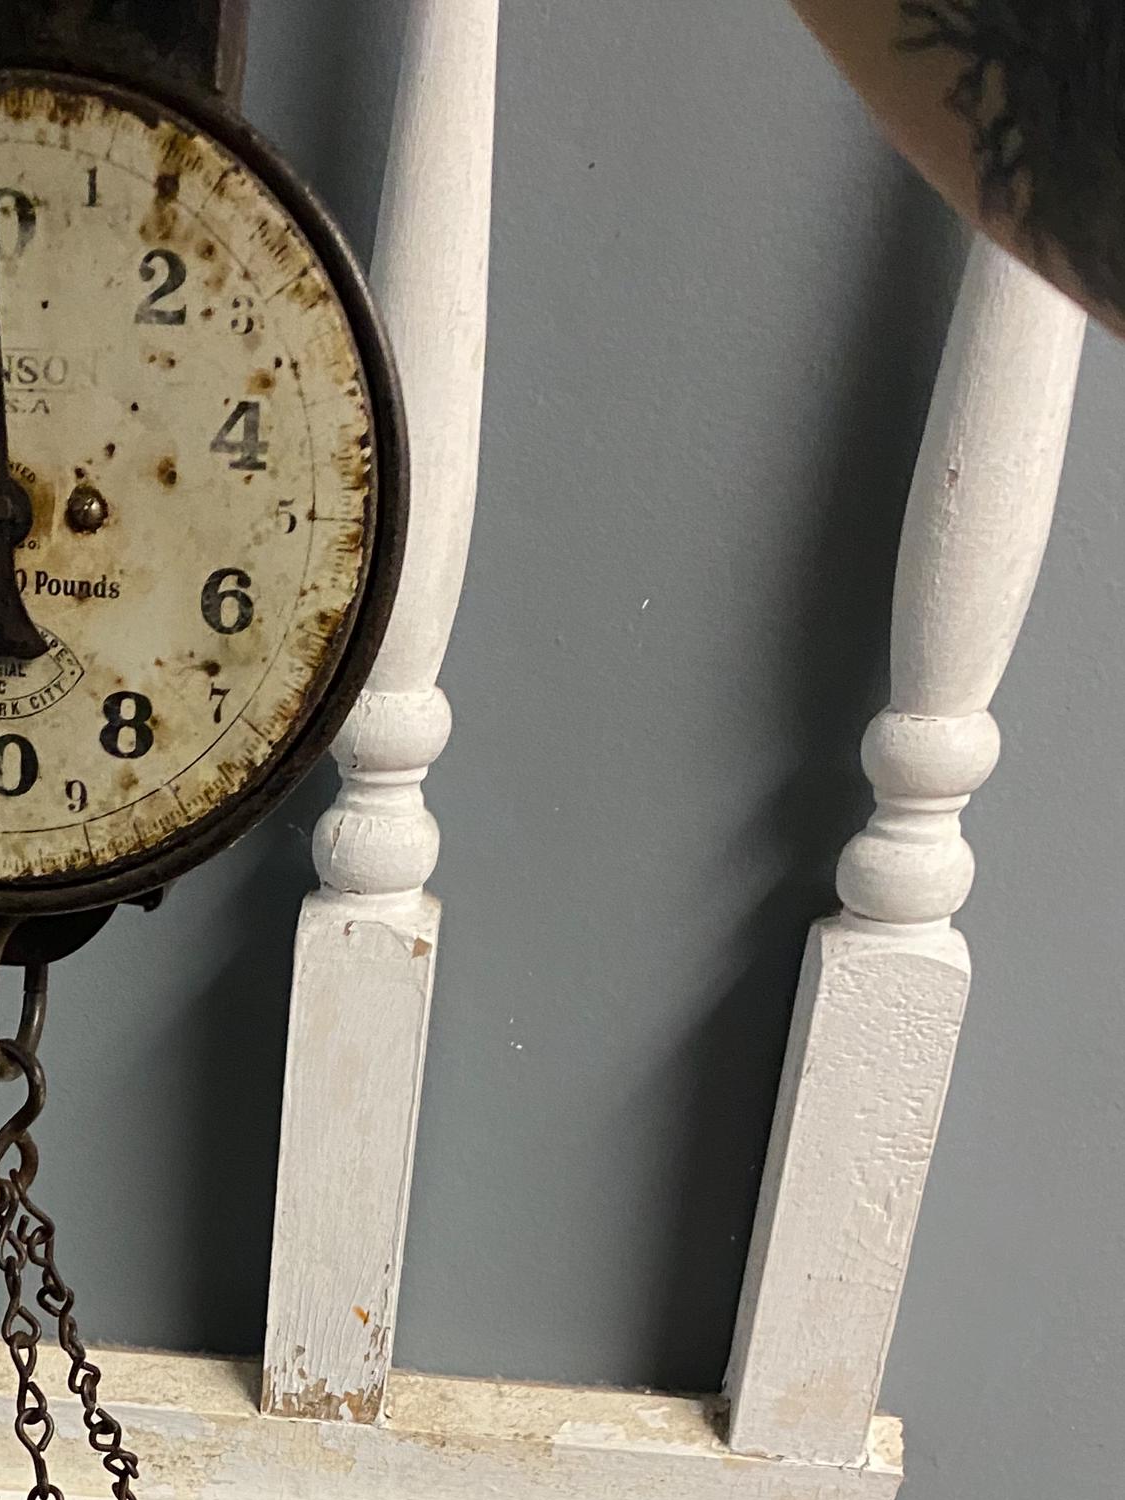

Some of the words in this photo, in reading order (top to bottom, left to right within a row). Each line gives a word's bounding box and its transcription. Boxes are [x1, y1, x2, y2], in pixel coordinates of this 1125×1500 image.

[83, 165, 102, 208] 1
[133, 248, 188, 326] 2
[209, 400, 270, 471] 4
[275, 498, 298, 535] 5
[34, 570, 121, 600] Pounds
[200, 566, 255, 636] 6
[29, 680, 67, 711] CITY
[208, 681, 231, 725] 7
[98, 690, 155, 760] 8
[64, 778, 88, 814] 9
